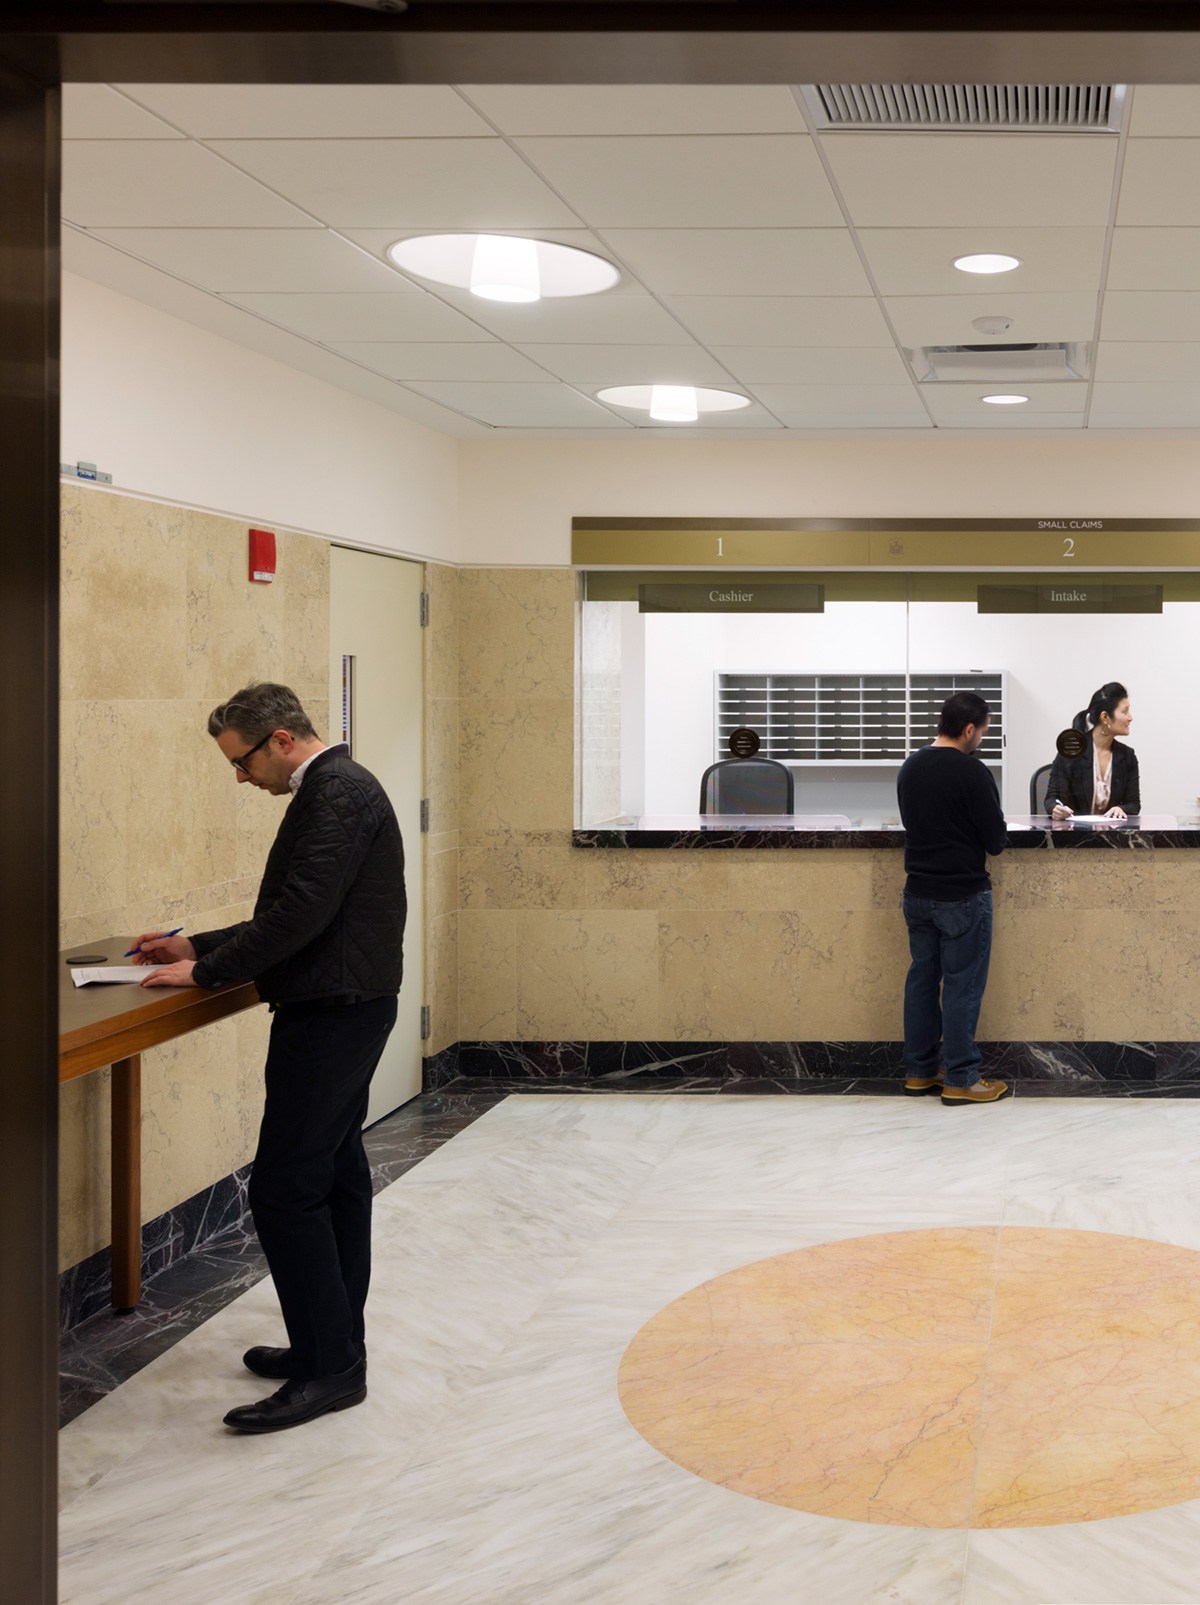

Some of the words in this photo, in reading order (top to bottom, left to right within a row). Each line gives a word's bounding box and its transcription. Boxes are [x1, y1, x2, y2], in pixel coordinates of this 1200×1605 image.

[1037, 520, 1067, 529] SMALL
[1069, 520, 1103, 529] CLAIMS
[716, 537, 725, 557] 1
[1062, 537, 1076, 557] 2
[709, 590, 755, 602] Cashier
[1050, 590, 1088, 602] Intake
